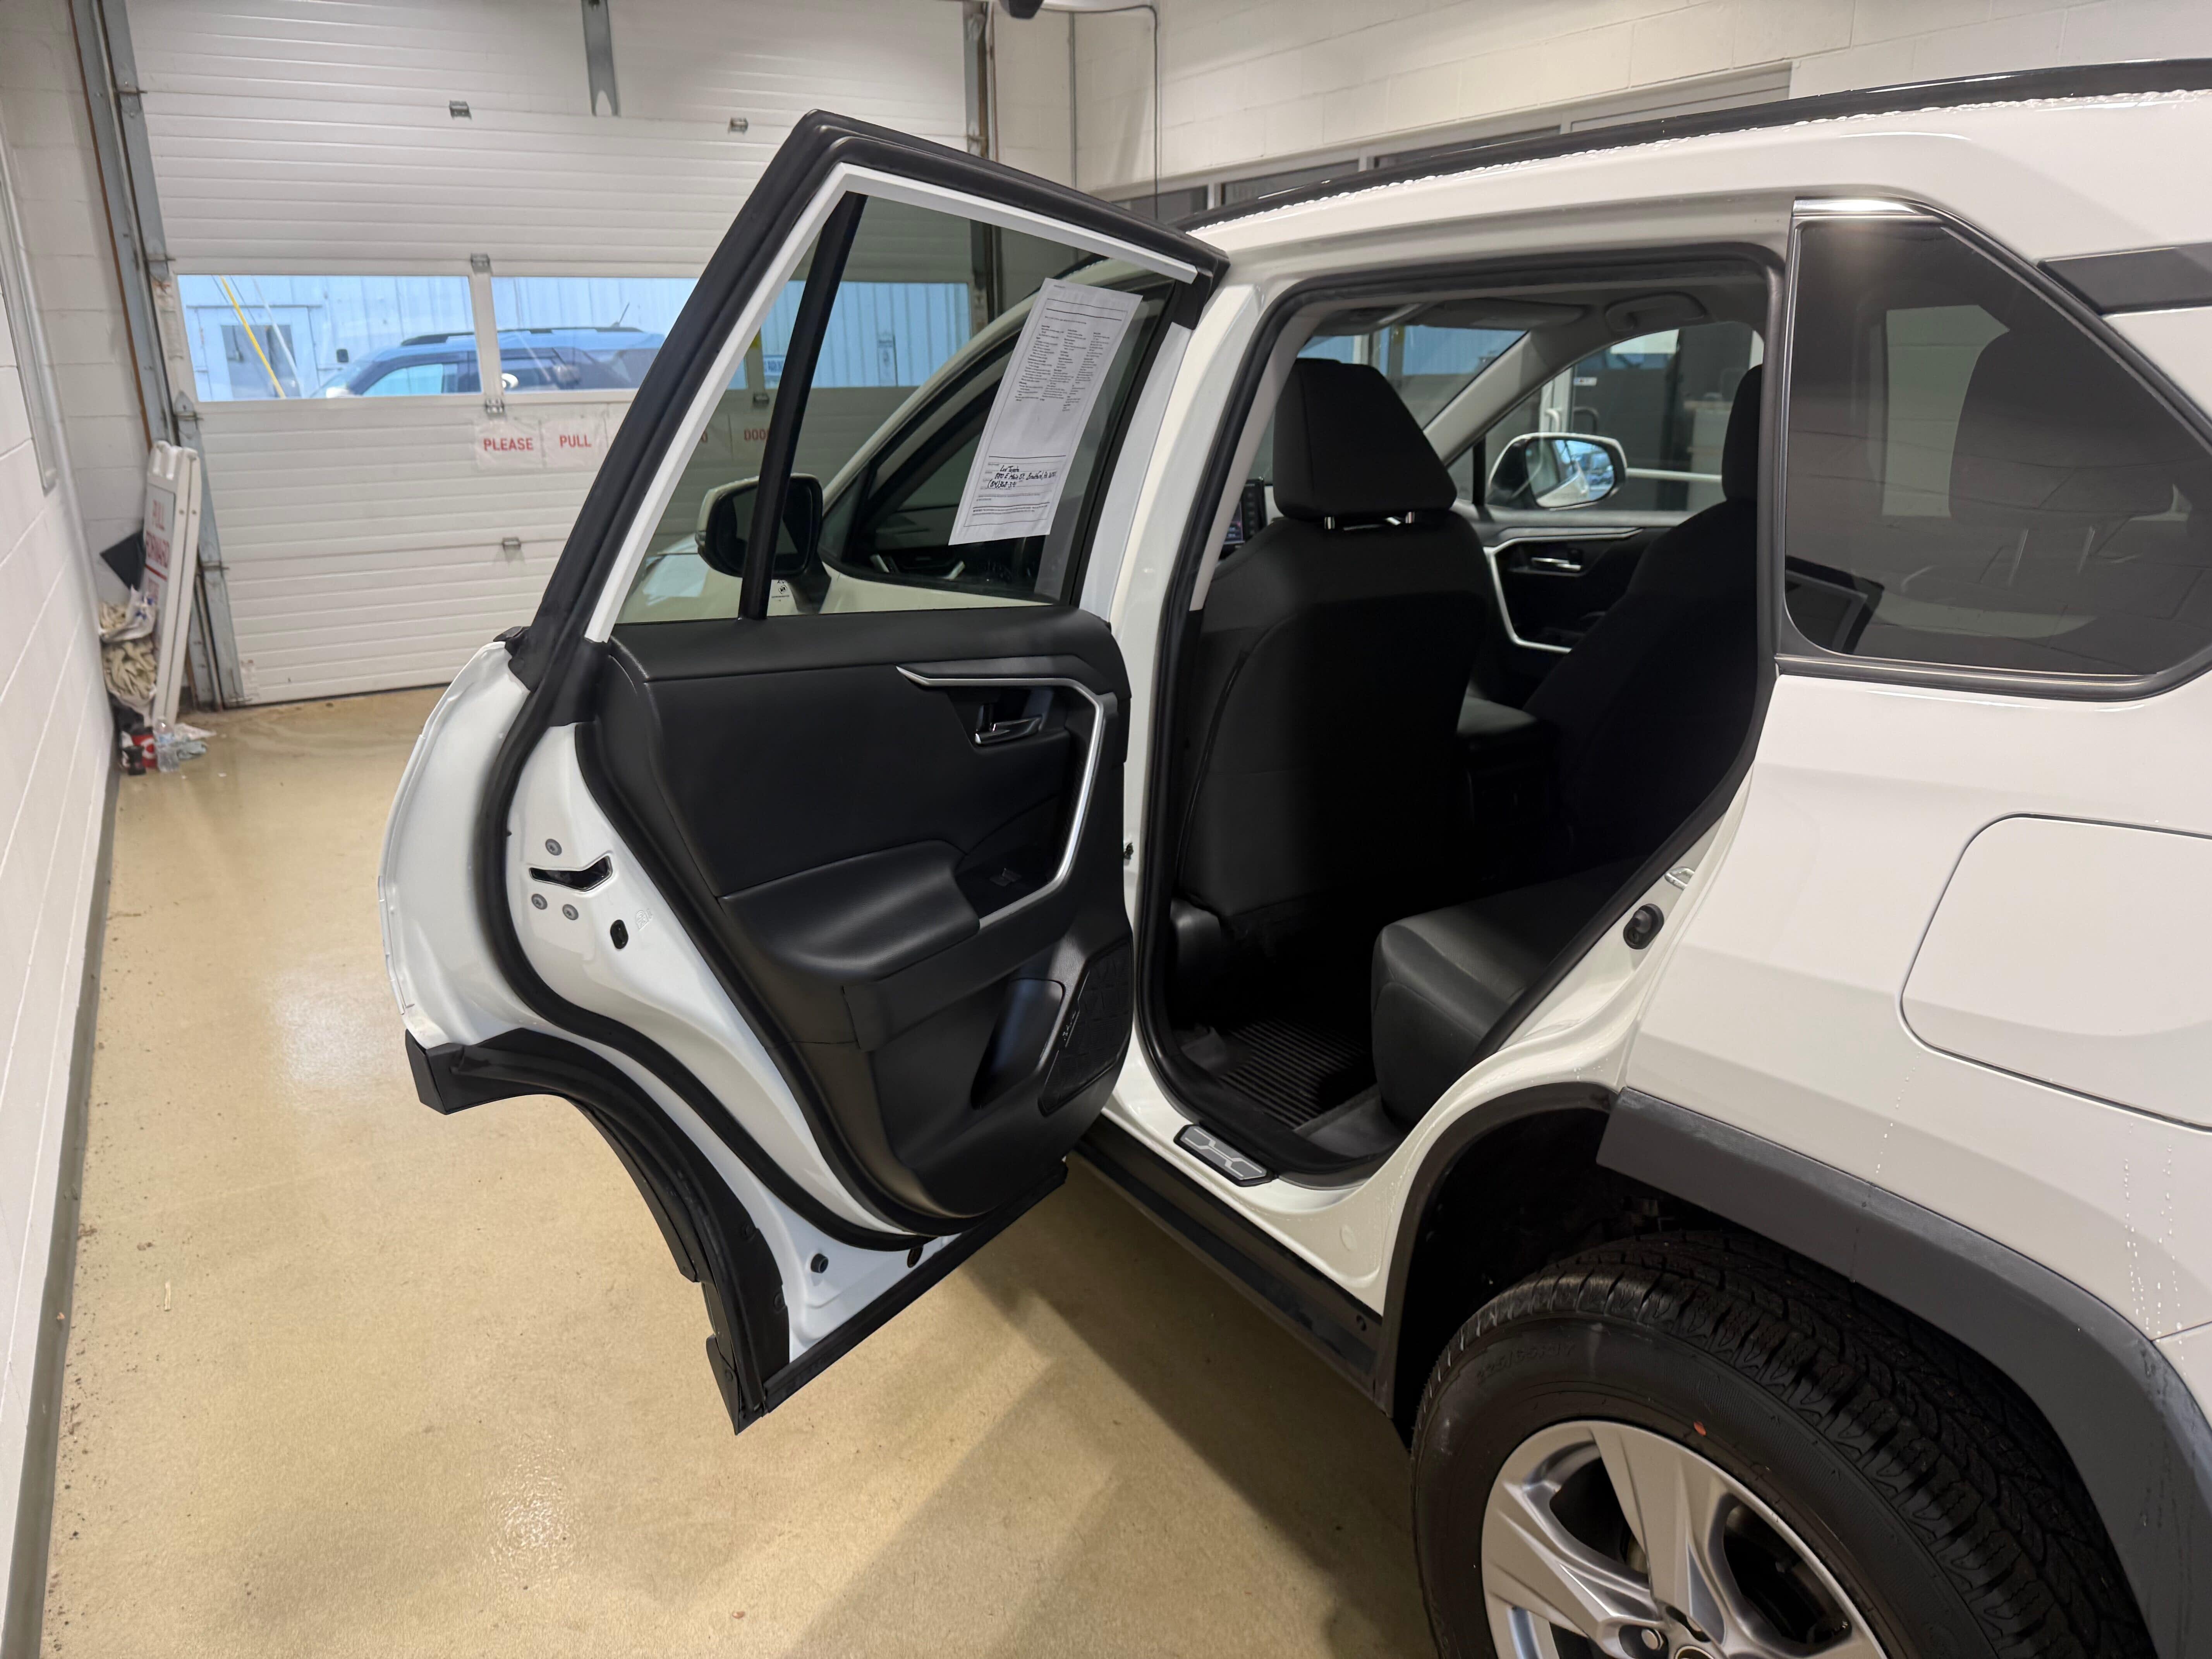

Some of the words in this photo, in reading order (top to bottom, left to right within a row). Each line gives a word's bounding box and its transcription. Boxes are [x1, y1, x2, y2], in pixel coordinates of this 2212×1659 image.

[483, 437, 534, 451] PLEASE
[559, 434, 592, 448] PULL
[743, 428, 769, 442] DOO
